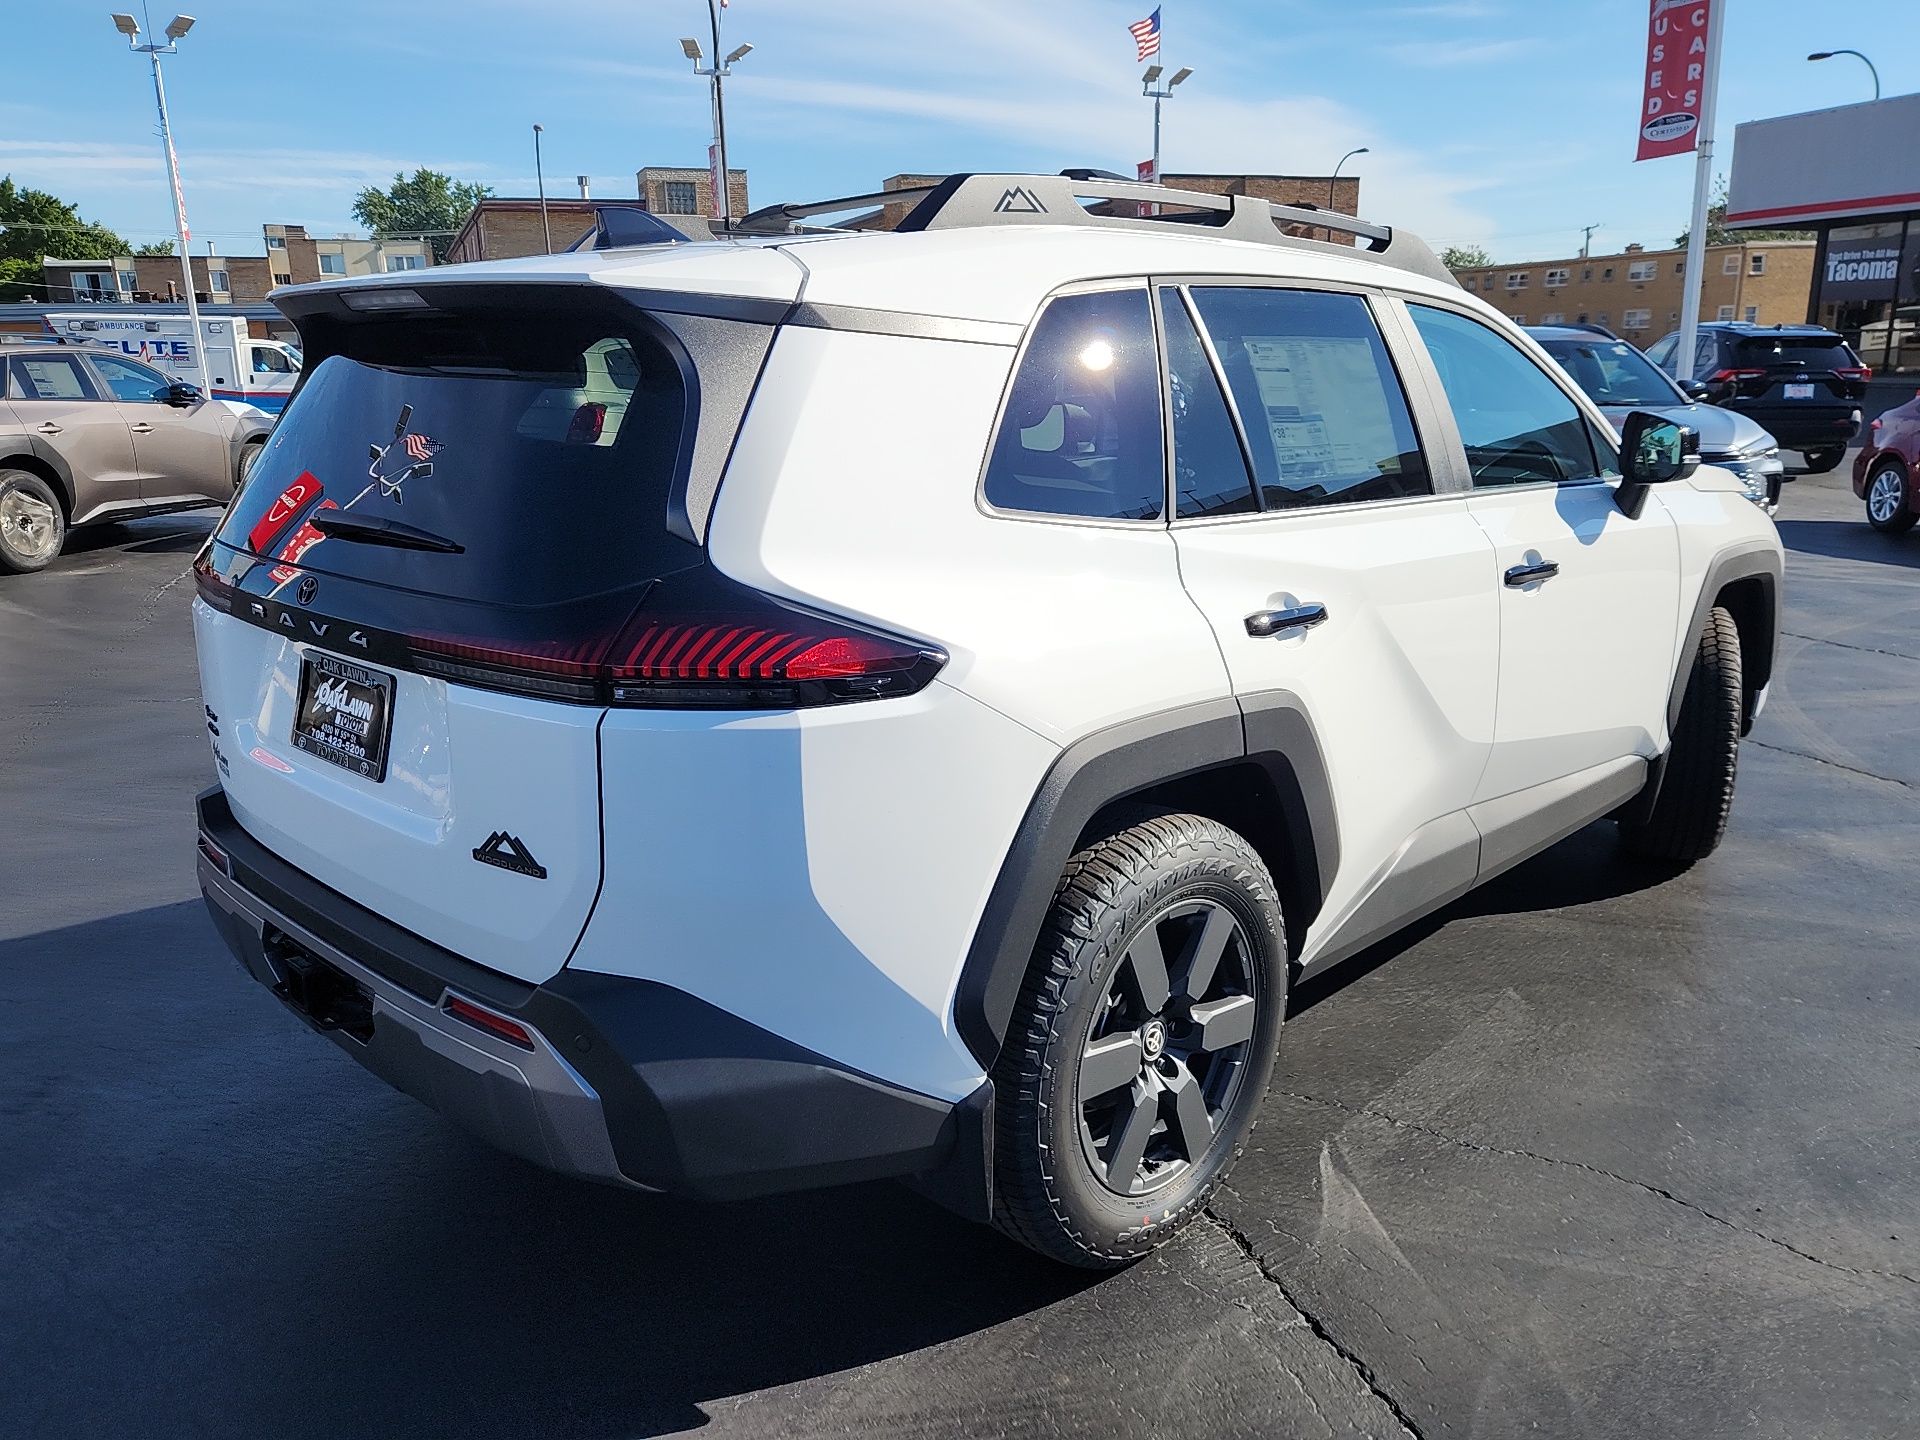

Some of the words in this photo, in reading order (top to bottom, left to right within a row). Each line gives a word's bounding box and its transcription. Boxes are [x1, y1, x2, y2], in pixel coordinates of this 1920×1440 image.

[1647, 17, 1668, 115] USED
[1683, 8, 1706, 108] CARS
[1862, 250, 1875, 259] The
[1828, 260, 1898, 281] Tacoma
[100, 323, 144, 331] AMBULANCE
[250, 601, 368, 649] RAV4
[323, 658, 340, 675] OAK
[341, 664, 367, 683] LAWN
[338, 713, 368, 736] TOYOTA
[311, 727, 367, 758] 708-423-5200
[316, 742, 349, 768] TOYOTA
[475, 852, 541, 877] WOODLAND
